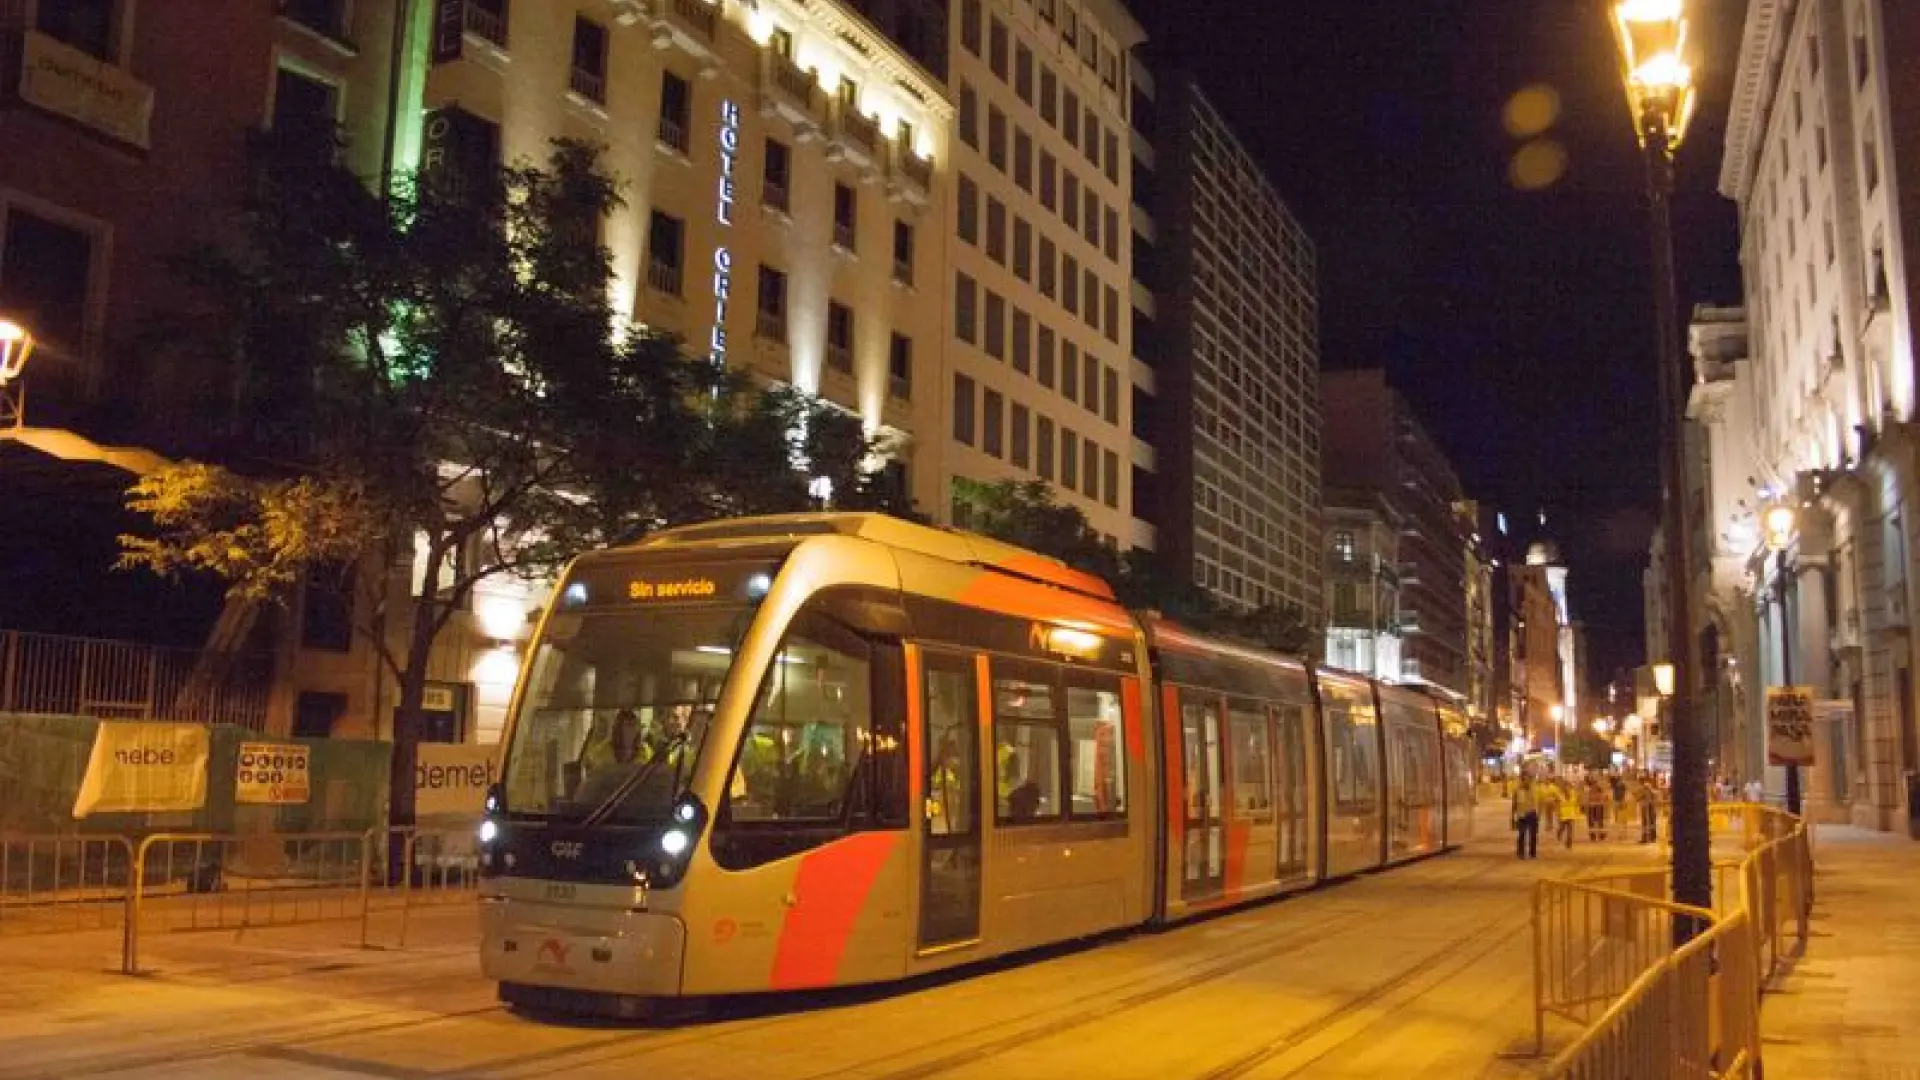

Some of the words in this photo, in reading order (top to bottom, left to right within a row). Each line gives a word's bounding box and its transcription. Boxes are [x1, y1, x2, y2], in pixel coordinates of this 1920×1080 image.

[717, 98, 739, 230] HOTEL
[629, 580, 654, 598] Sin
[657, 576, 716, 597] servicio
